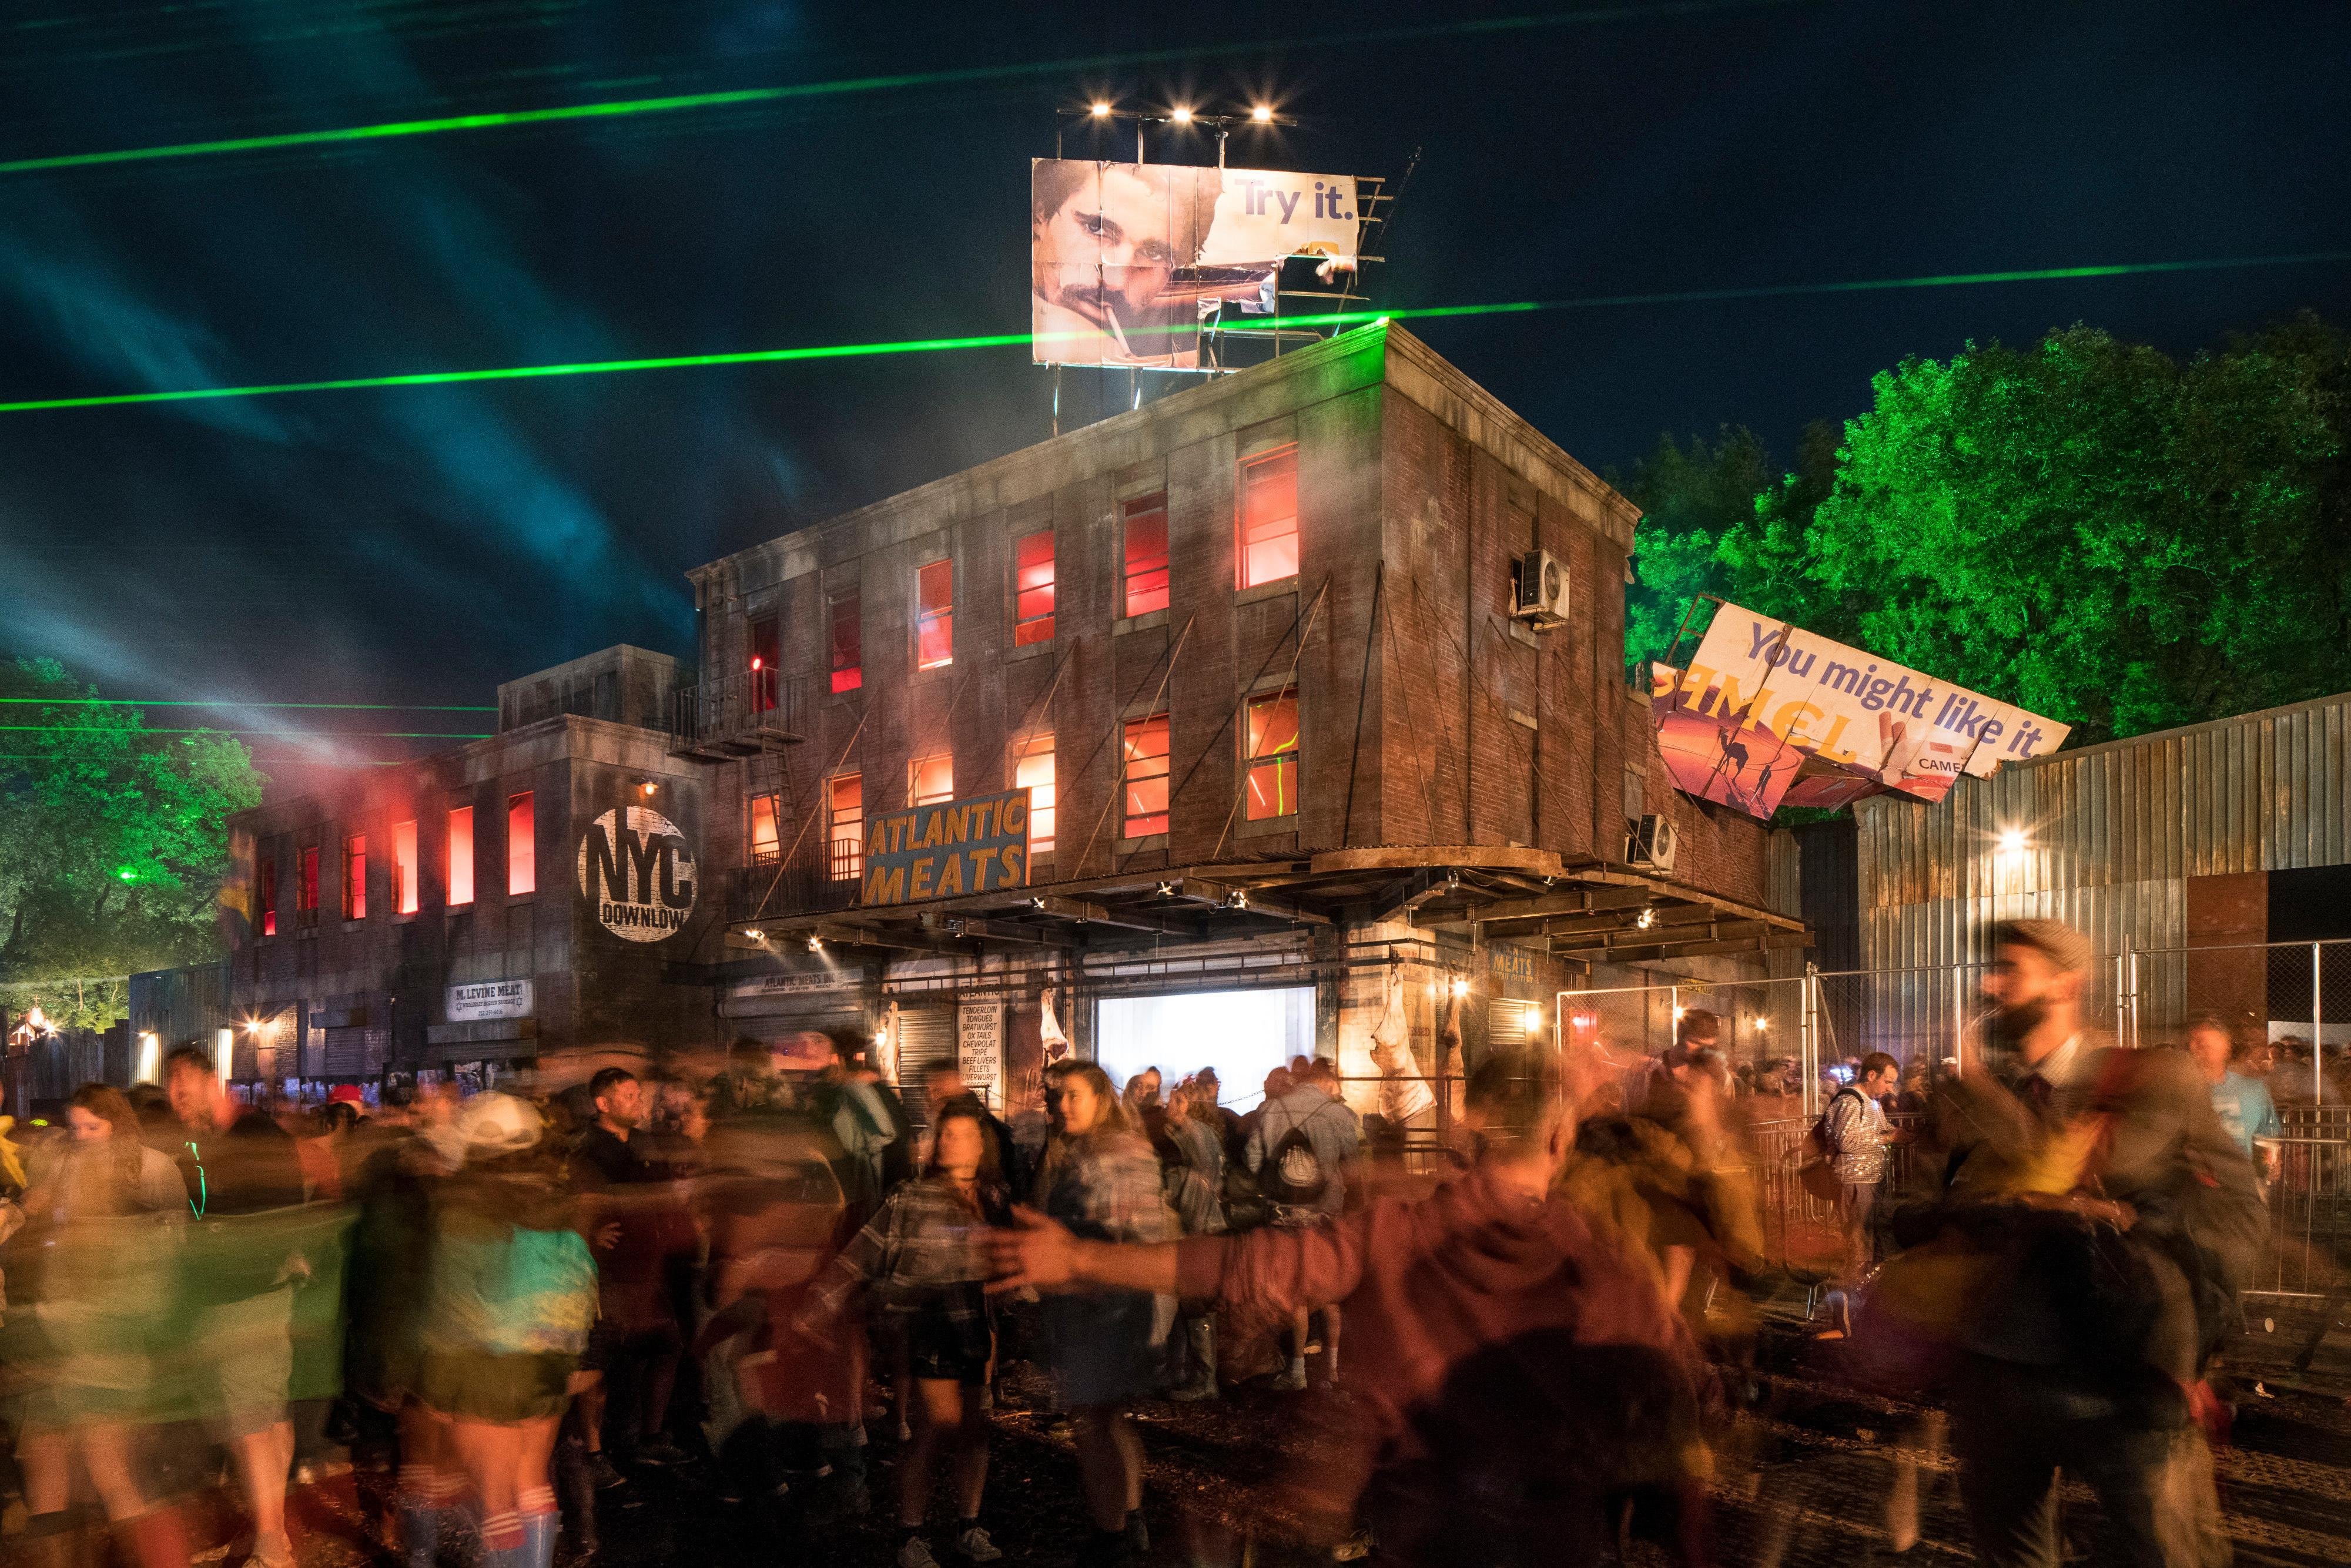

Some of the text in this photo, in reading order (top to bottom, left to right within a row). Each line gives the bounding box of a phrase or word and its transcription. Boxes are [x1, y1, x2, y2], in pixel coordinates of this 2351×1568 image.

[1235, 178, 1353, 225] Try it.
[1747, 621, 1817, 678] You
[1819, 660, 1933, 719] might
[1934, 692, 2004, 744] like
[1918, 758, 1964, 773] CAME
[866, 796, 1027, 856] ATLANTIC
[585, 808, 694, 910] NYC
[862, 844, 1023, 906] MEATS
[602, 903, 685, 930] DOWNLOW
[1493, 953, 1532, 976] MEATS
[467, 986, 495, 999] LEVINE
[963, 1006, 997, 1015] TENDERLOIN
[963, 1023, 997, 1031] BRATWURST
[963, 1056, 997, 1065] BEEF LIVERS
